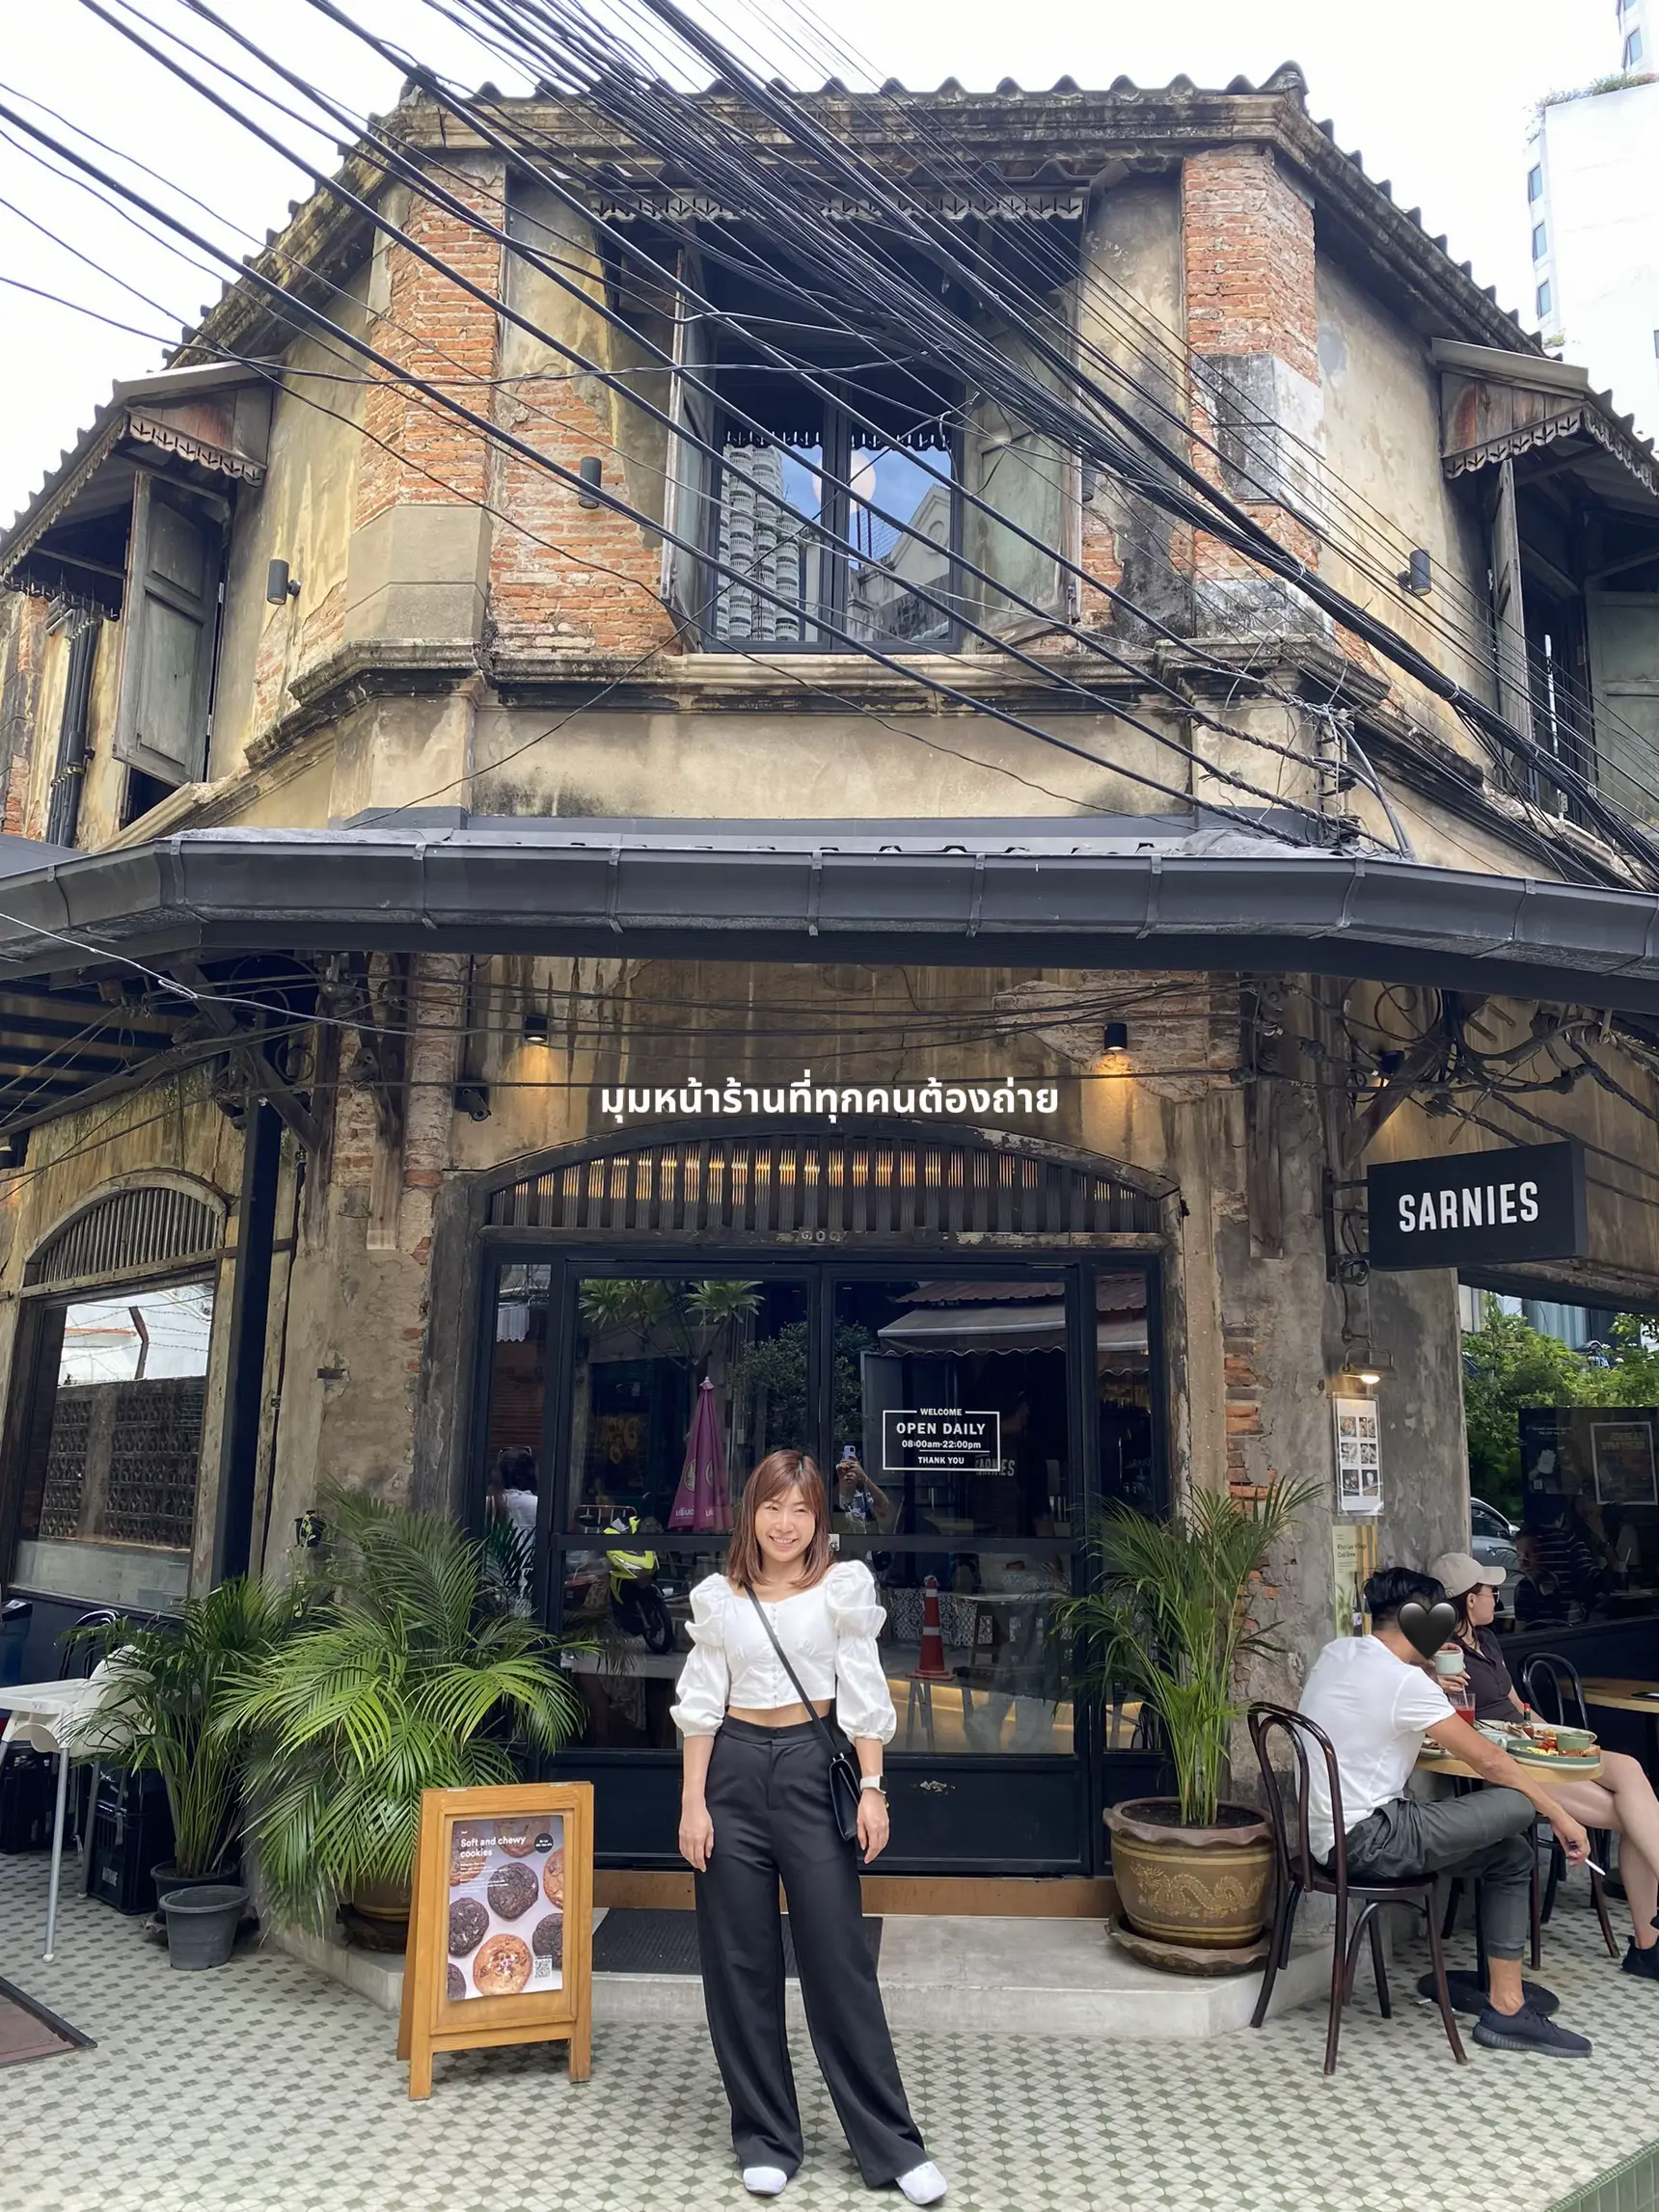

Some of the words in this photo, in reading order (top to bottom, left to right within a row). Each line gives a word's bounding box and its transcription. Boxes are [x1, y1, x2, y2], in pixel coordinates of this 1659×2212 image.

[1399, 1181, 1539, 1232] SARNIES
[896, 1422, 937, 1435] OPEN
[942, 1423, 986, 1435] DAILY
[902, 1440, 981, 1449] 08:00am-22:00pm
[917, 1456, 946, 1465] THANK
[947, 1456, 965, 1465] YOU
[461, 1838, 478, 1848] Soft
[479, 1837, 497, 1846] and
[498, 1836, 526, 1847] chewy
[460, 1848, 493, 1858] cookies
